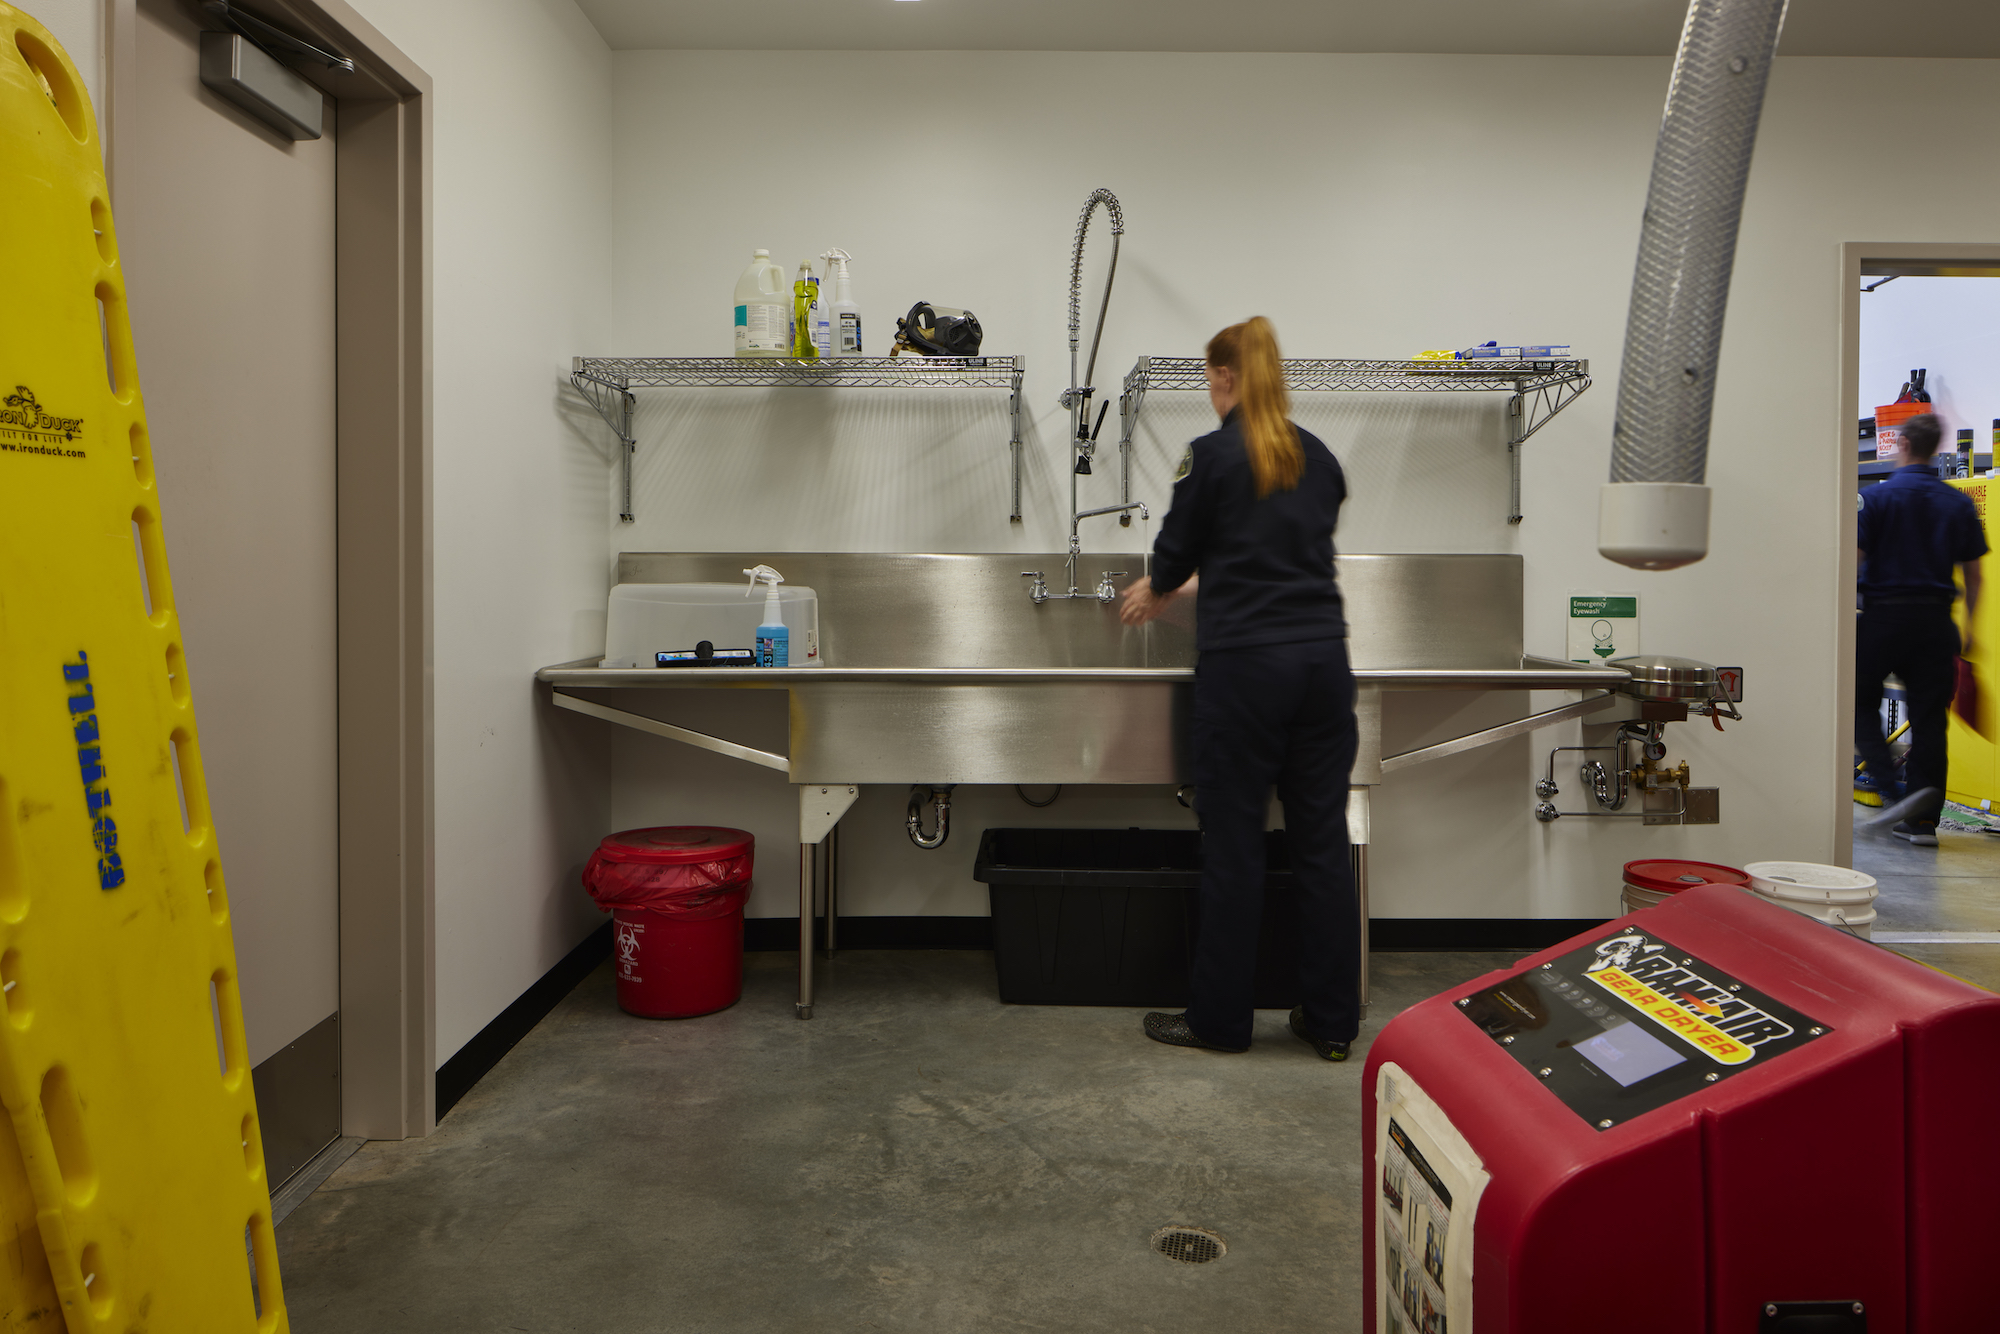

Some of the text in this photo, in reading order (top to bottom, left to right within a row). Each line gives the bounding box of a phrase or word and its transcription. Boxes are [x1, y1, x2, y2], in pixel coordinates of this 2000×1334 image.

[22, 432, 38, 442] FOR
[43, 435, 62, 444] LIFE
[38, 412, 82, 433] DUCK
[63, 650, 125, 890] BOTHELL
[1599, 972, 1659, 1006] GEAR
[1654, 1007, 1740, 1055] DRYER
